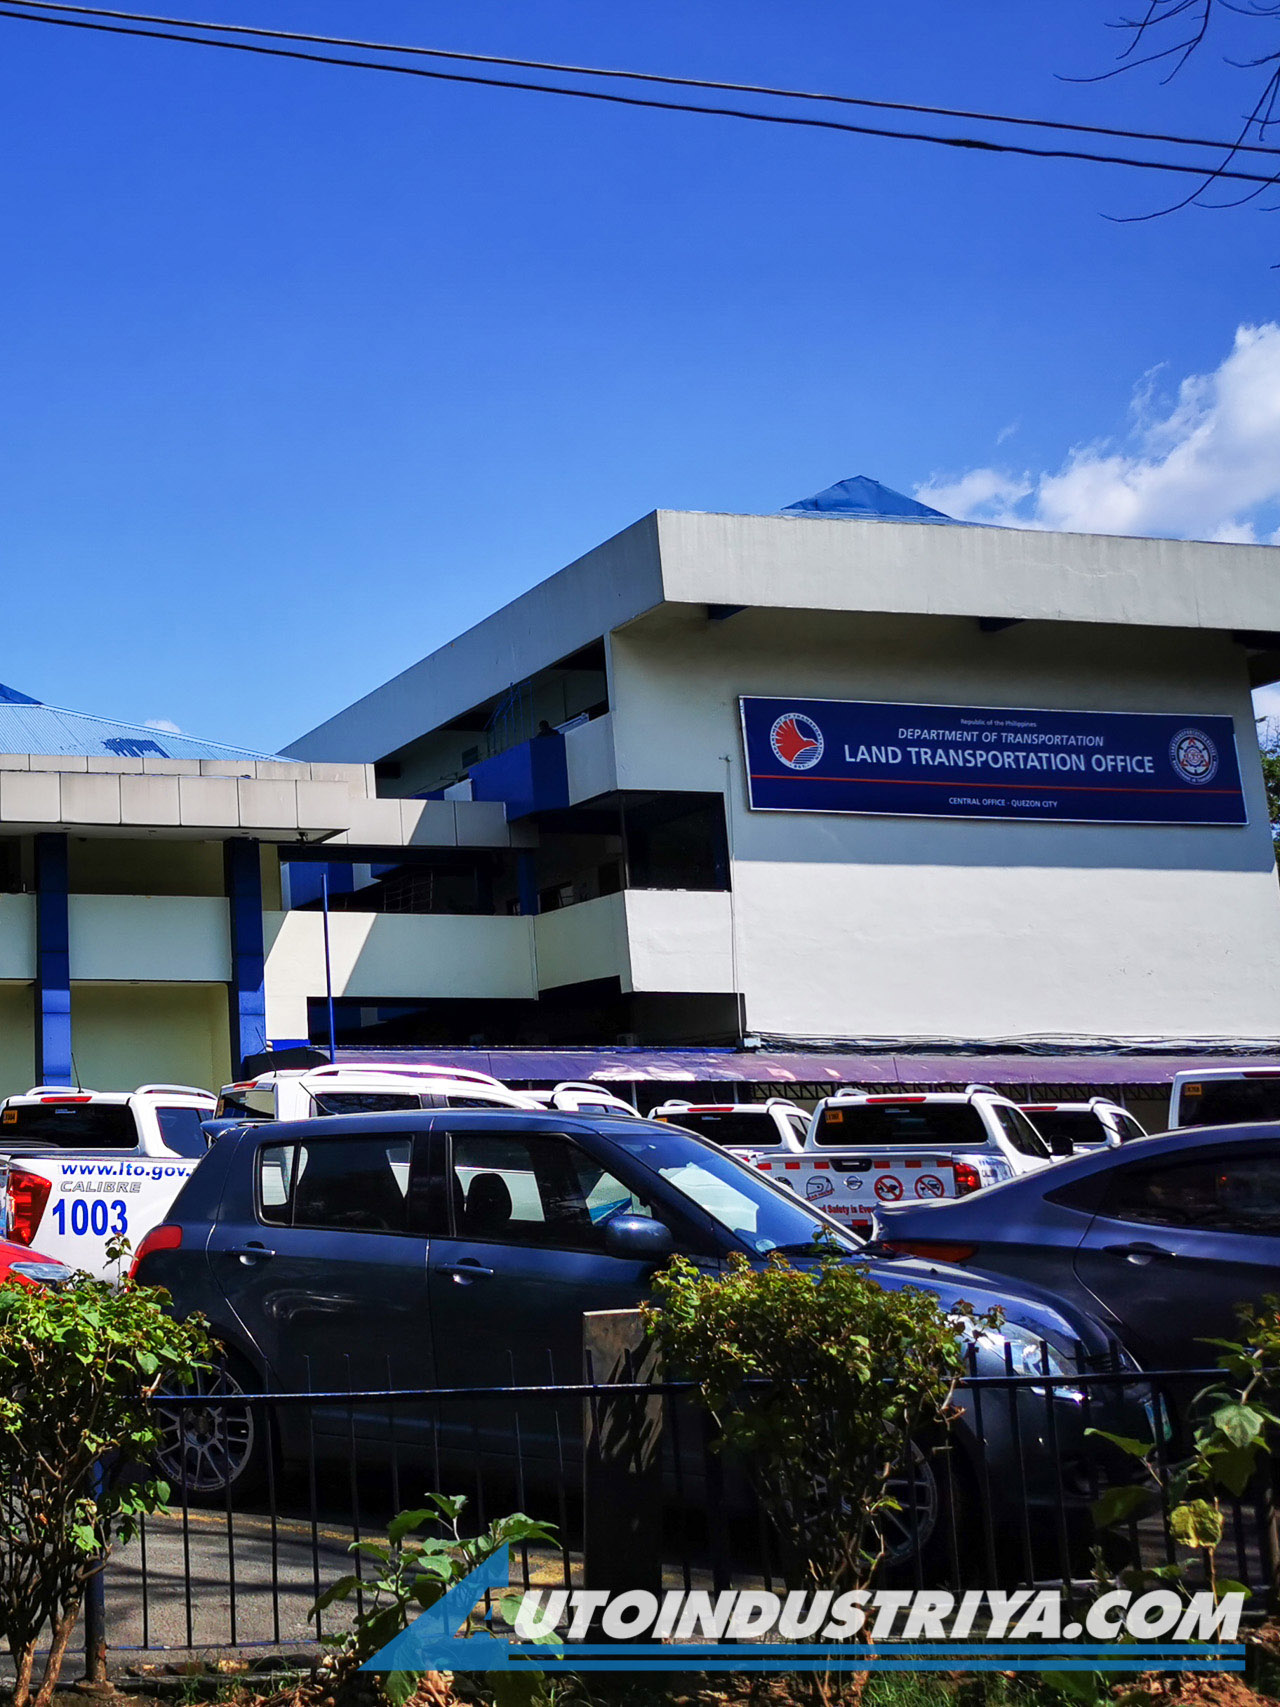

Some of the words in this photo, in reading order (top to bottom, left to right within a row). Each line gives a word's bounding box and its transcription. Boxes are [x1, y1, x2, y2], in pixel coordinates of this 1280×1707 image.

[960, 718, 985, 726] Republic
[1005, 720, 1037, 728] Philippines
[898, 728, 979, 742] DEPARTMENT
[982, 731, 998, 743] OF
[1001, 732, 1104, 747] TRANSPORTATION
[844, 744, 902, 764] LAND
[906, 747, 1086, 772] TRANSPORTATION
[1091, 754, 1155, 773] OFFICE
[948, 797, 981, 806] CENTRAL
[981, 798, 1006, 807] OFFICE
[1011, 799, 1041, 808] QUEZON
[1042, 800, 1058, 808] CITY
[61, 1162, 192, 1181] www.lto.gov.
[60, 1181, 142, 1193] CALIBRE
[52, 1199, 128, 1236] 1003
[827, 1205, 849, 1215] Safety
[850, 1205, 857, 1213] is
